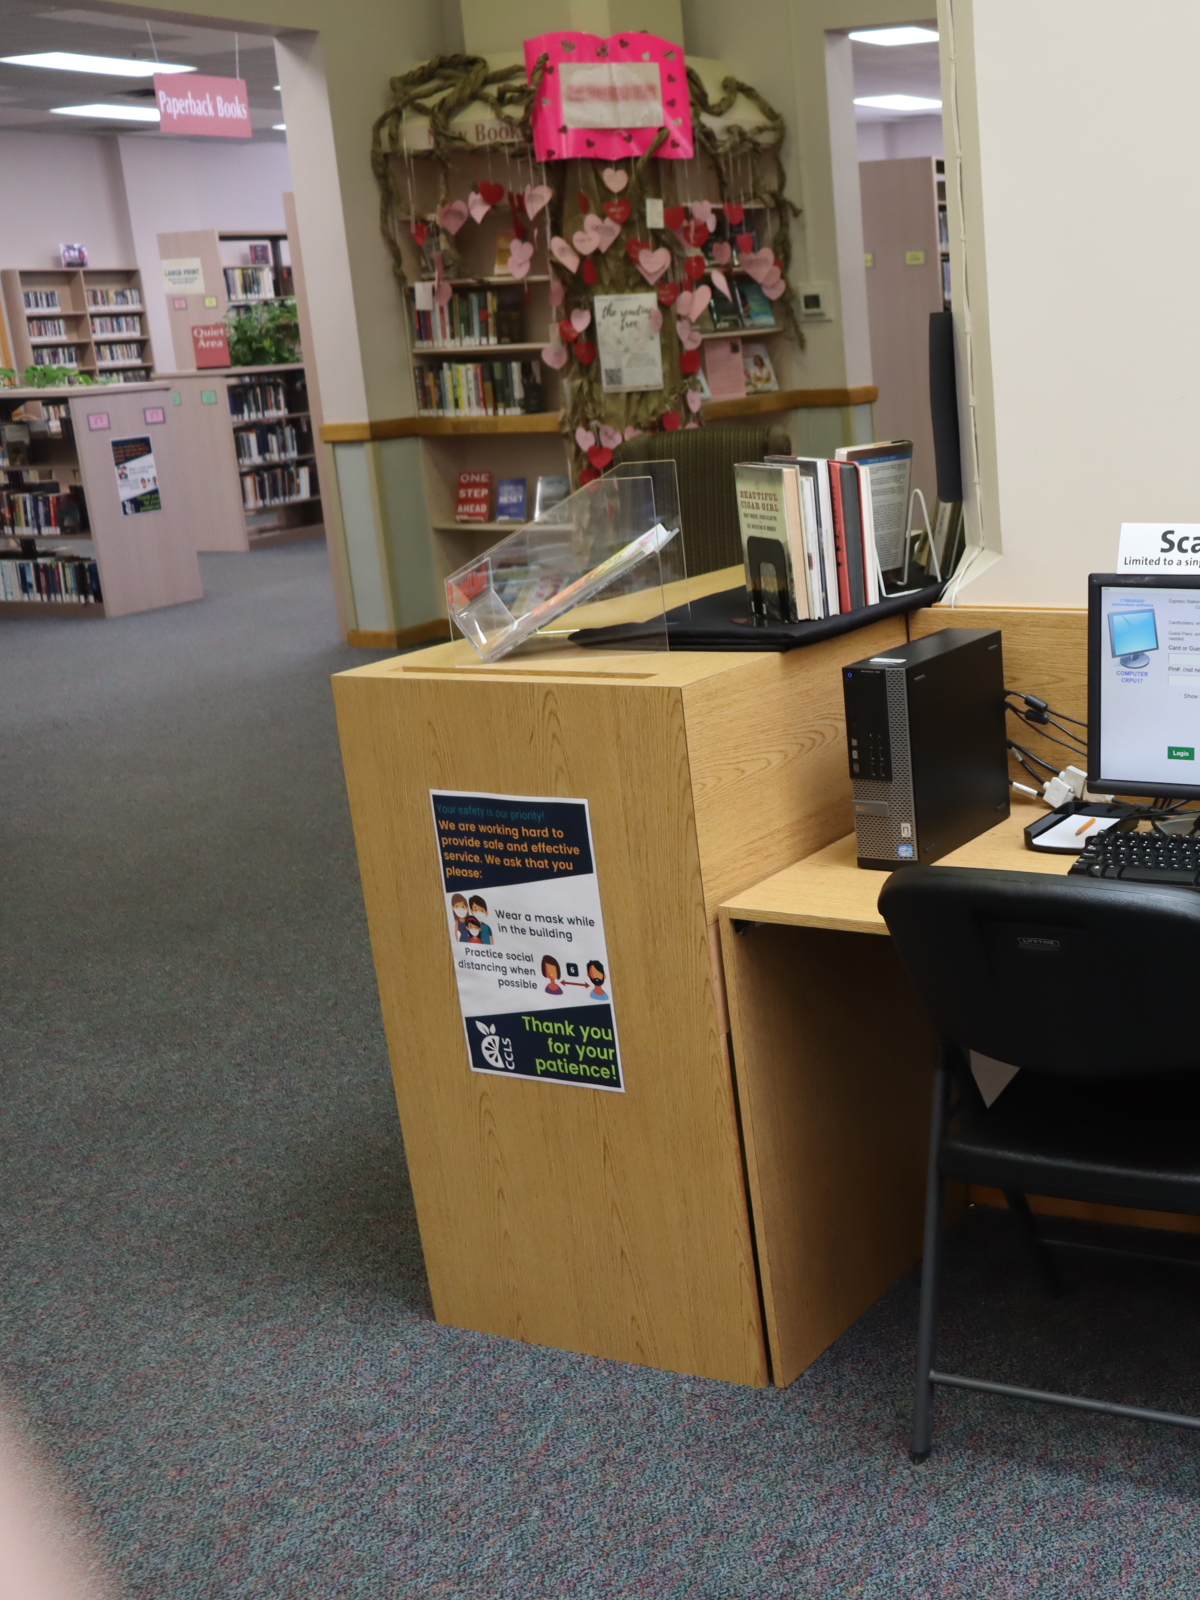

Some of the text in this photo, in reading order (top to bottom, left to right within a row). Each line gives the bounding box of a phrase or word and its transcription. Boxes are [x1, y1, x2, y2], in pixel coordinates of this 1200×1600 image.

[158, 90, 248, 120] Paperback Books
[474, 123, 522, 142] Book
[164, 269, 182, 277] LARGE
[193, 326, 225, 339] Quiet
[198, 339, 223, 348] Area
[460, 473, 489, 483] ONE
[459, 488, 489, 498] STEP
[740, 491, 778, 501] BEAUTIFUL
[457, 504, 487, 513] AHEAD
[741, 501, 779, 512] CIGAR GIRL
[1124, 556, 1160, 566] Limited
[1163, 558, 1173, 566] to
[436, 804, 544, 822] Your safety is our priority!
[438, 820, 564, 839] We are working hard to
[441, 836, 580, 855] provide safe and effective
[444, 851, 573, 872] service. We ask that you
[446, 866, 483, 878] please:
[495, 909, 521, 920] Wear
[535, 915, 564, 924] mask
[566, 916, 595, 927] while
[497, 923, 573, 942] in the building
[465, 947, 534, 962] Practice social
[458, 960, 536, 976] distancing when
[498, 979, 538, 989] possible
[521, 1016, 613, 1042] Thank you
[501, 1037, 515, 1070] CCLS
[547, 1038, 614, 1061] for your
[535, 1058, 616, 1080] patience!
